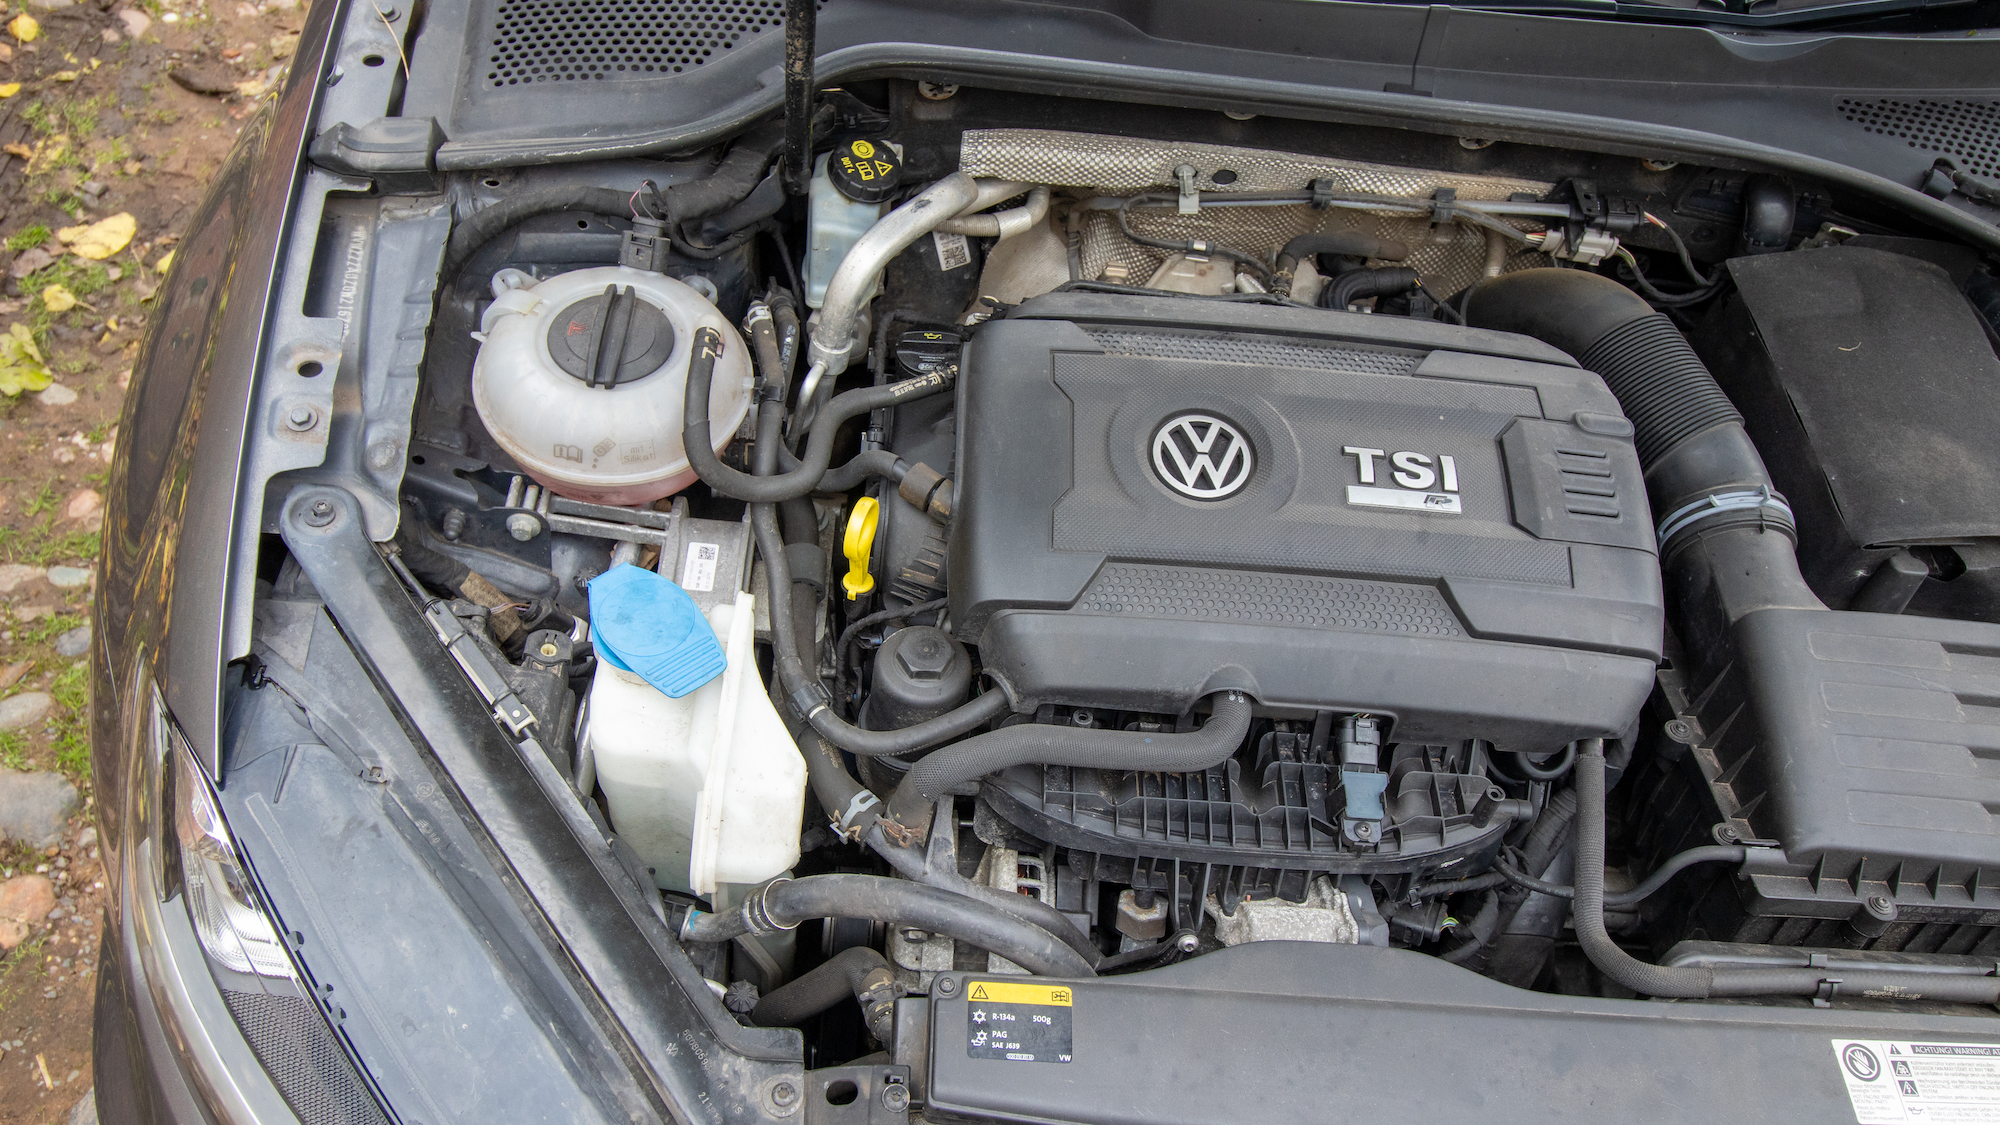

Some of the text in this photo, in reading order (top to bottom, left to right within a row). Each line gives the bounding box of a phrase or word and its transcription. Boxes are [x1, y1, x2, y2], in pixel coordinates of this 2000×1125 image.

[841, 156, 853, 168] DOT
[630, 445, 644, 454] mit
[623, 453, 654, 463] Silikat
[1343, 445, 1459, 493] TSI
[992, 1012, 1052, 1025] R-134a 500g
[992, 1030, 1008, 1039] PAG
[1005, 1042, 1020, 1050] J639
[1915, 1046, 1953, 1054] ACHTUNG!
[1953, 1047, 1992, 1056] WARNING!
[1059, 1054, 1072, 1062] VW
